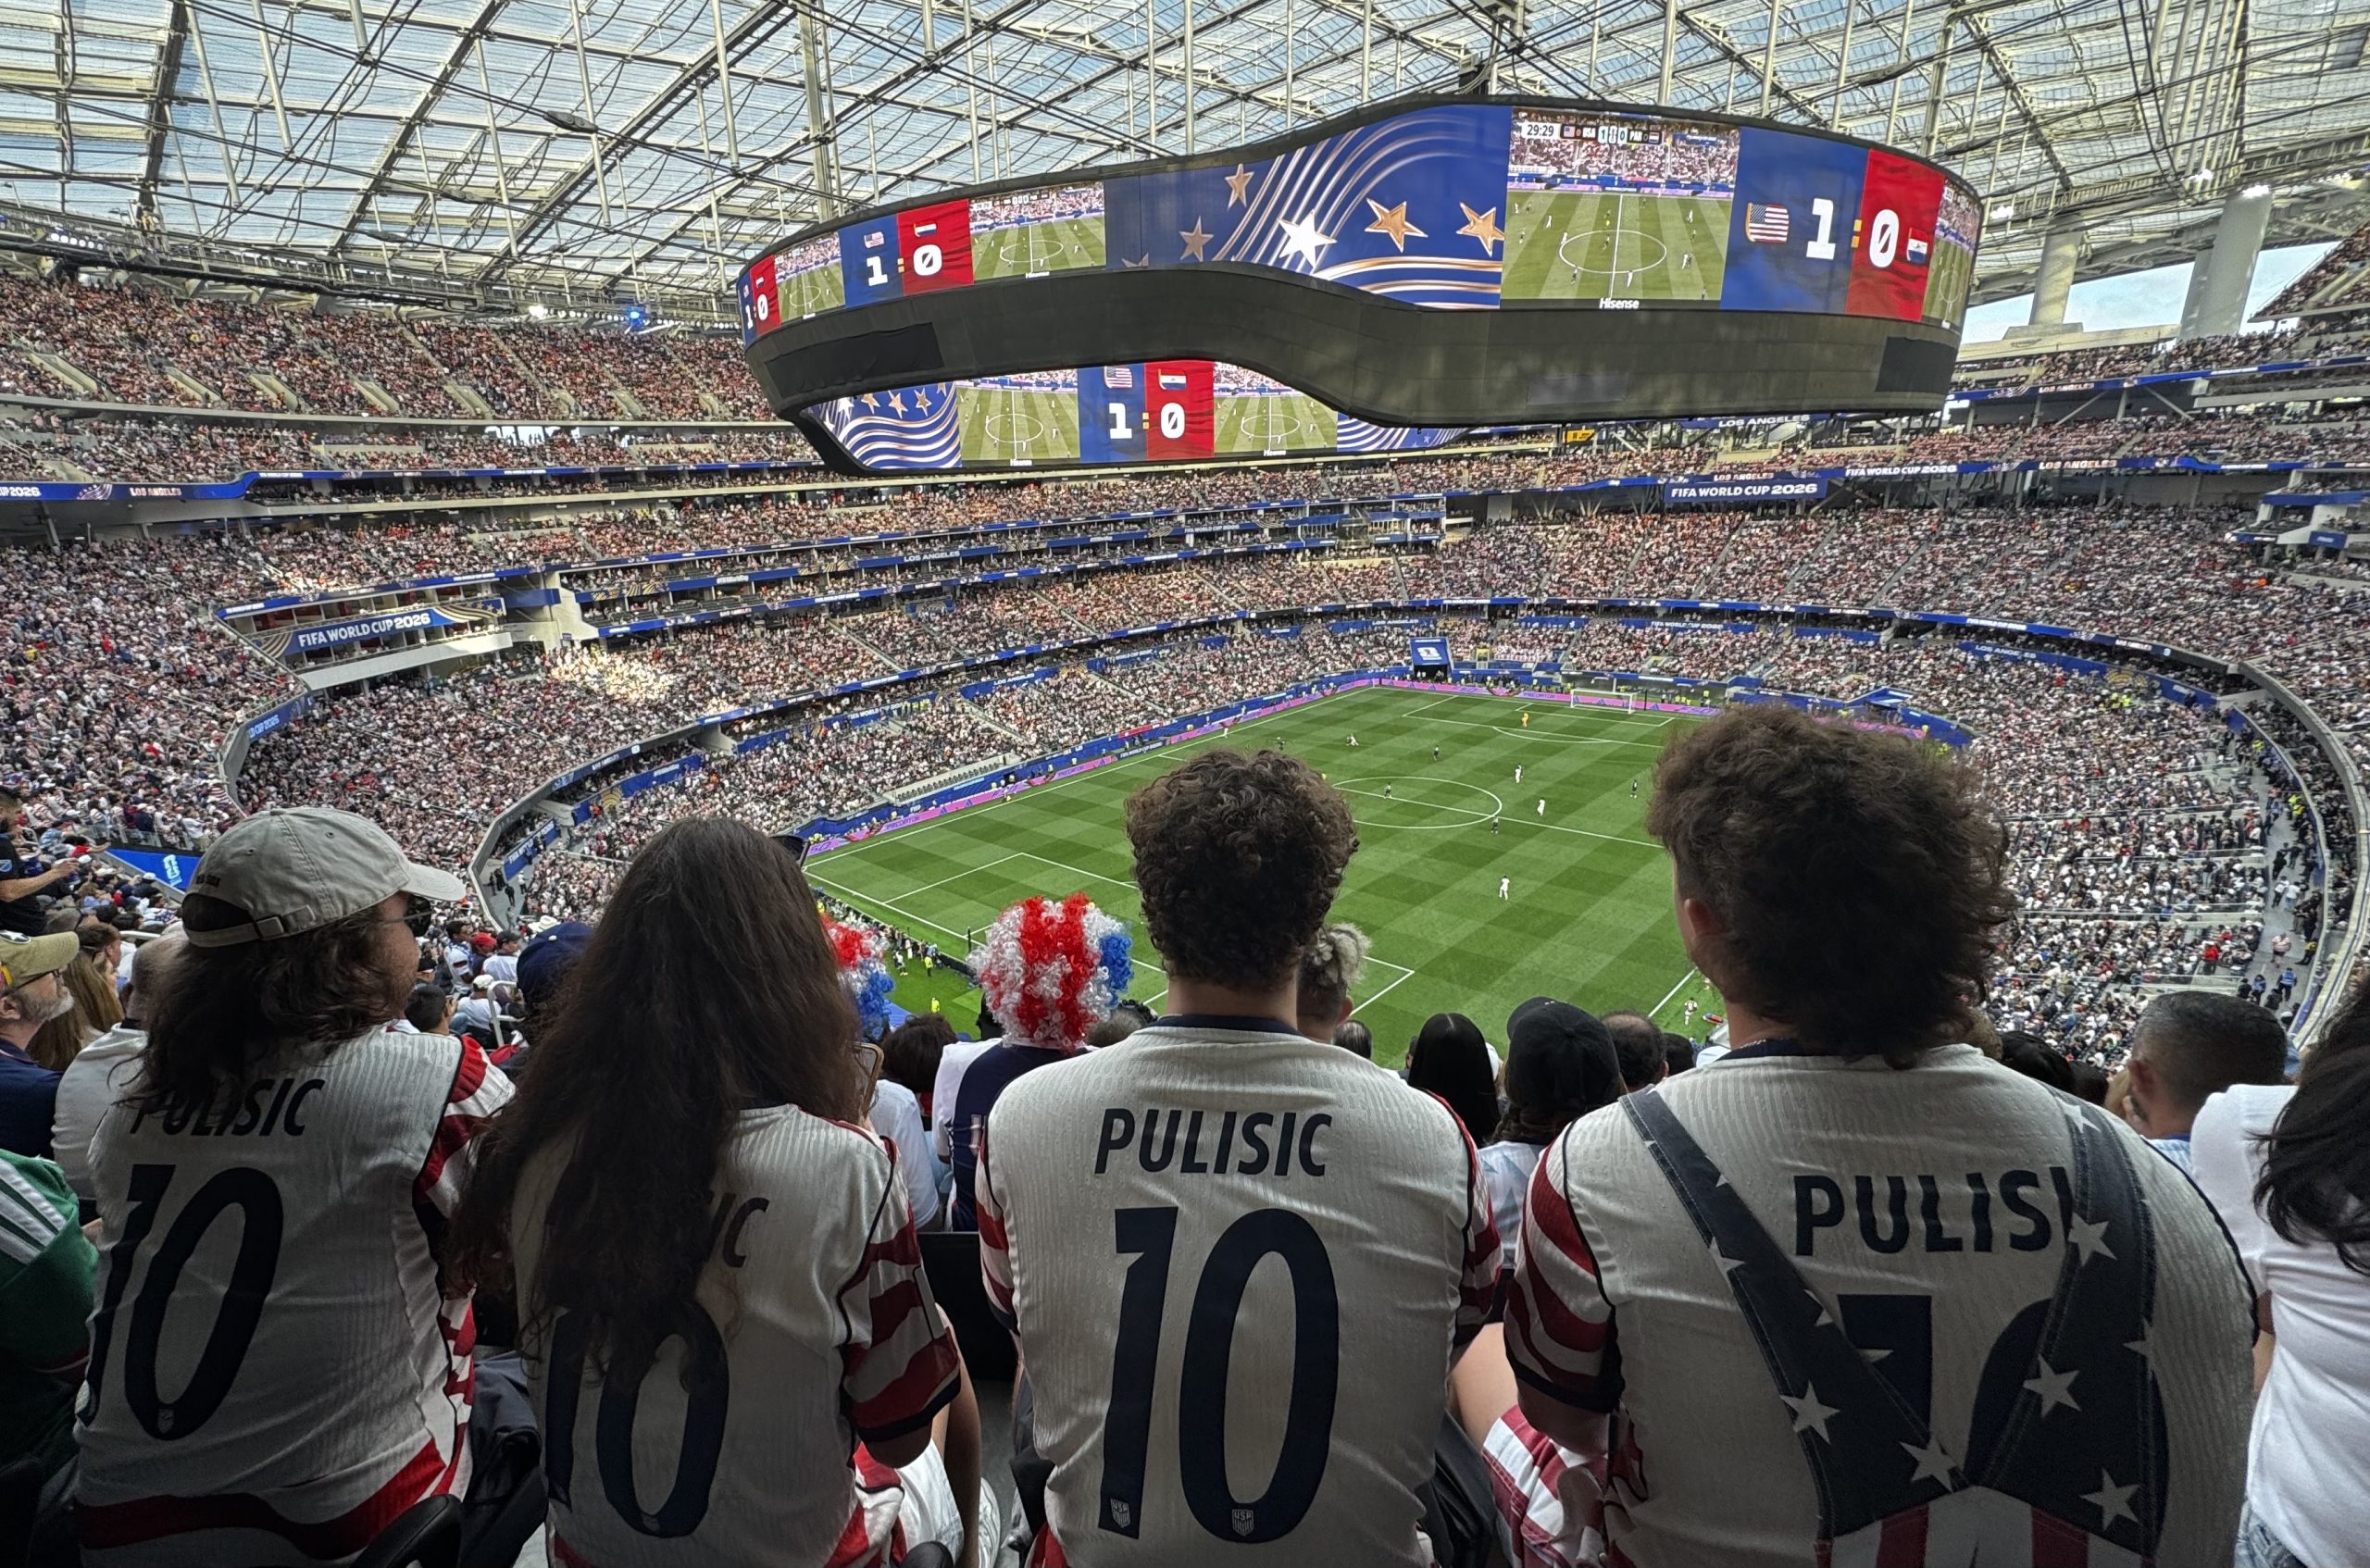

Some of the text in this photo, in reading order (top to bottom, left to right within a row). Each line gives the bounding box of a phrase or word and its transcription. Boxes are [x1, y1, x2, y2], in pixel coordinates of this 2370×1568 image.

[1527, 124, 1554, 137] 29:29
[1599, 297, 1640, 309] Hisense
[1718, 414, 1811, 428] LOS ANGELES
[2039, 459, 2118, 470] LOS ANGELES
[1714, 472, 1774, 481] LOS ANGELES
[1845, 465, 1958, 477] FIFA WORLD CUP 2026
[9, 487, 42, 497] 2026
[130, 487, 182, 497] LOS ANGELES
[1671, 483, 1818, 498] FIFA WORLD CUP 2026
[904, 551, 961, 563] LOS ANGELES
[298, 613, 431, 648] FIFA WORLD CUP 2026
[1975, 644, 2037, 659] LOS ANGEES
[910, 804, 921, 813] FIFA
[1094, 1108, 1332, 1176] PULISIC
[76, 1164, 283, 1441] 10
[1098, 1206, 1339, 1544] 10
[1112, 1501, 1129, 1513] USA
[1233, 1512, 1252, 1521] USA
